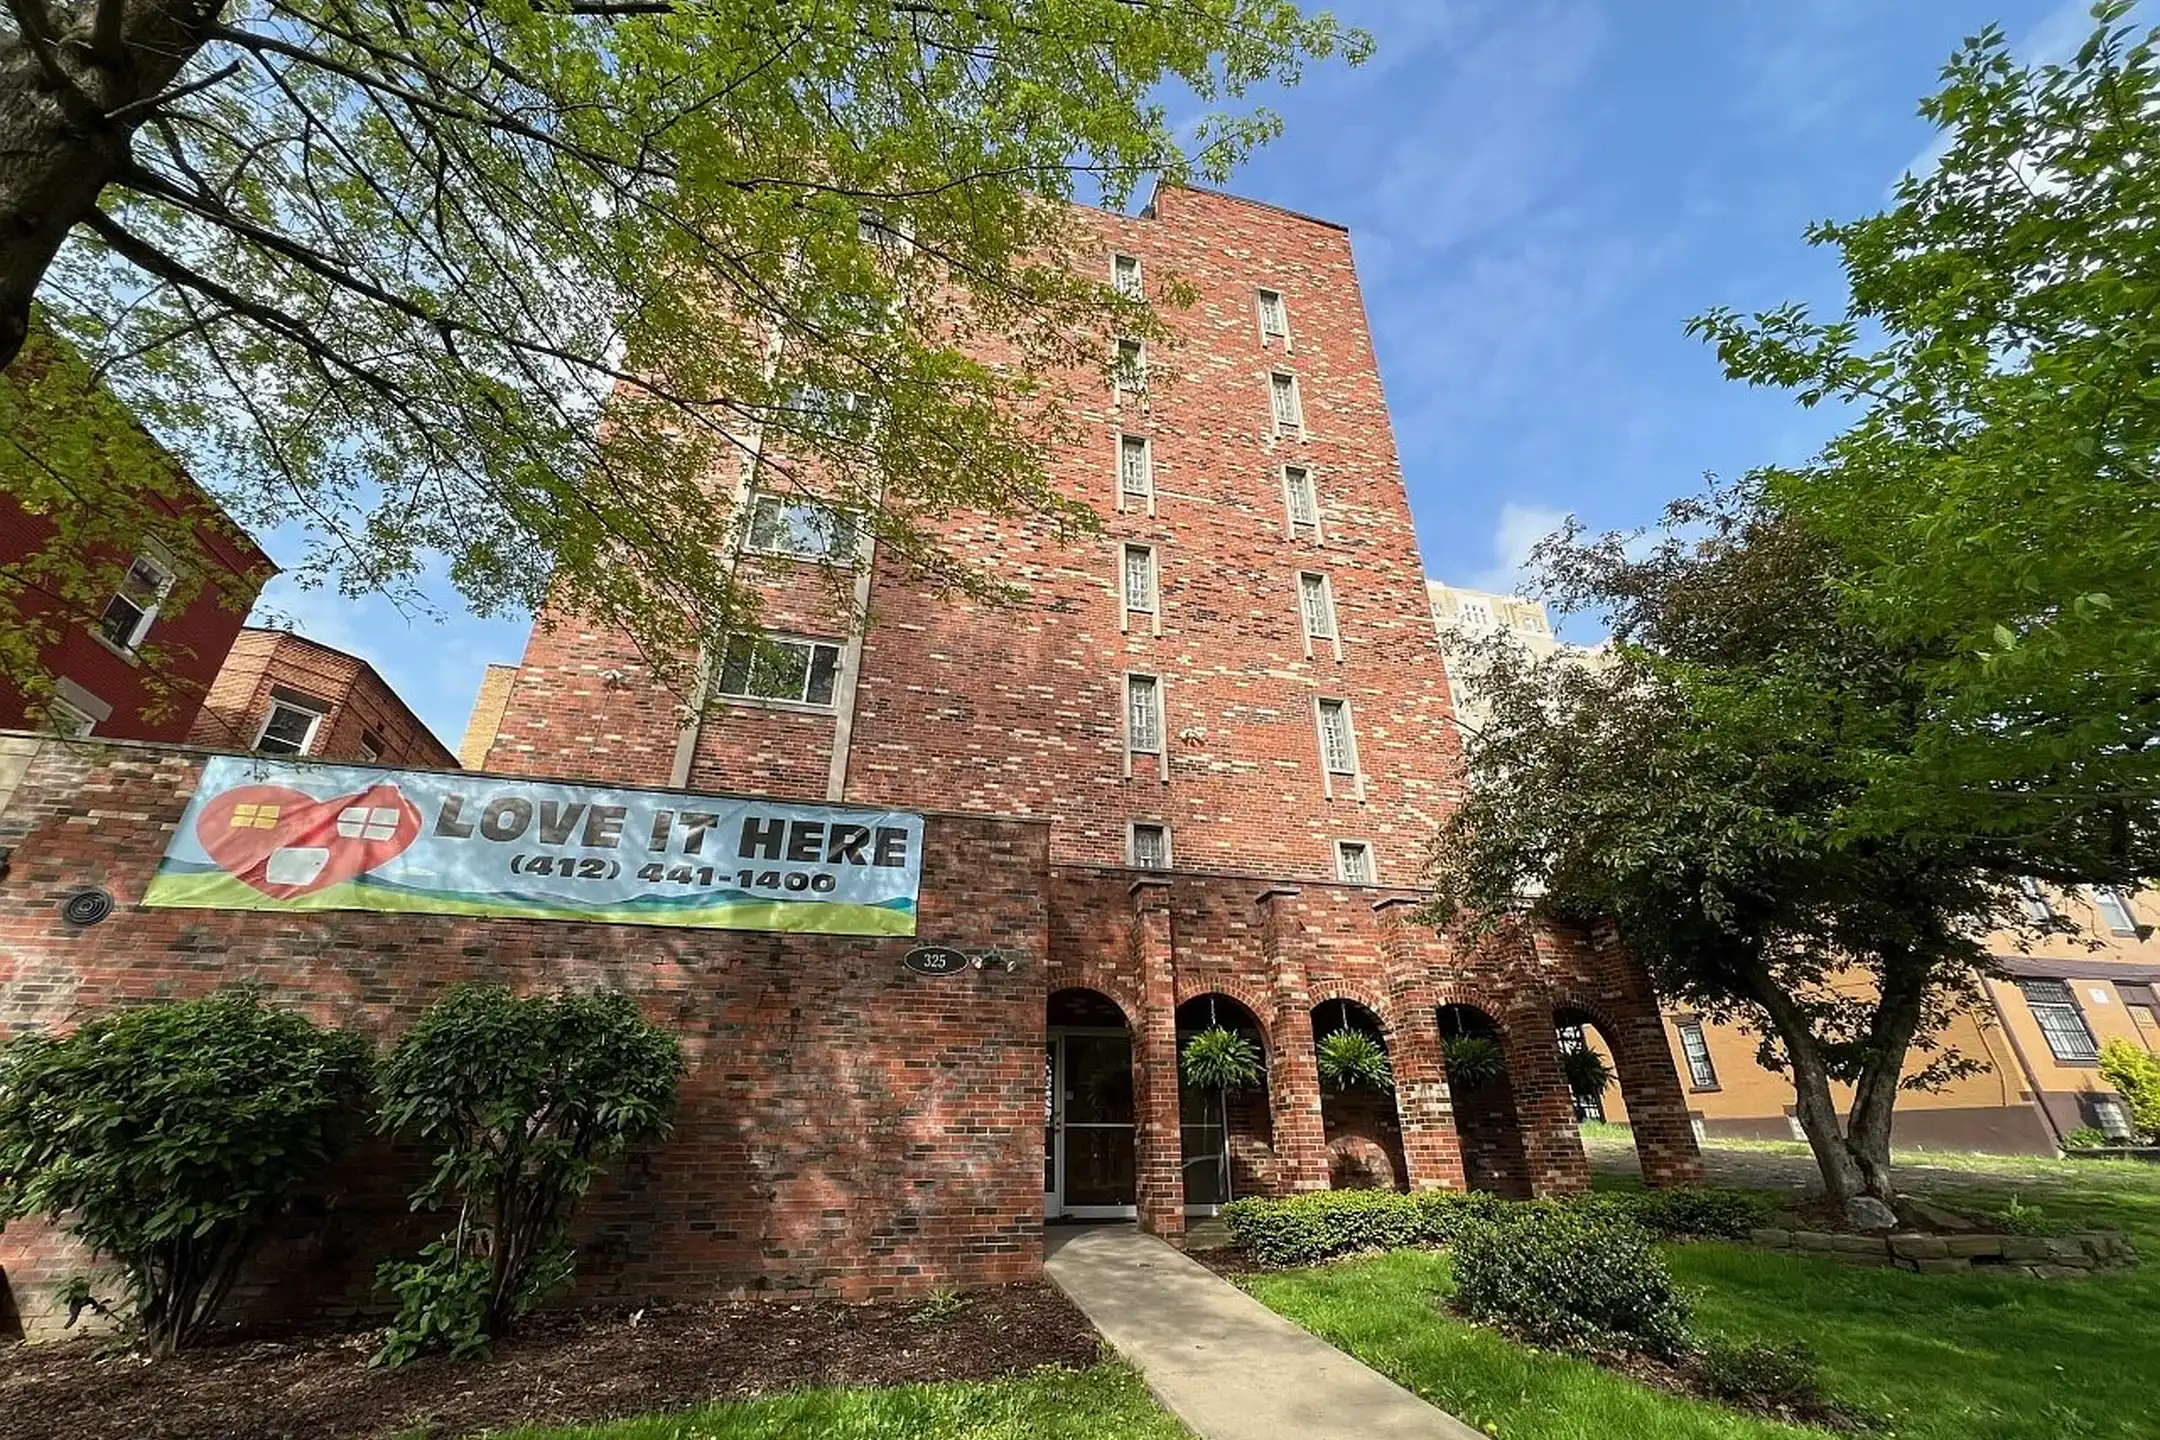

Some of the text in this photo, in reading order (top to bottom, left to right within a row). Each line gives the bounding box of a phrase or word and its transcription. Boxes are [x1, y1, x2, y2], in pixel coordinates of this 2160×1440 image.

[434, 795, 909, 867] LOVE IT HERE
[510, 854, 836, 892] (412) 441-1400
[923, 953, 947, 969] 325
